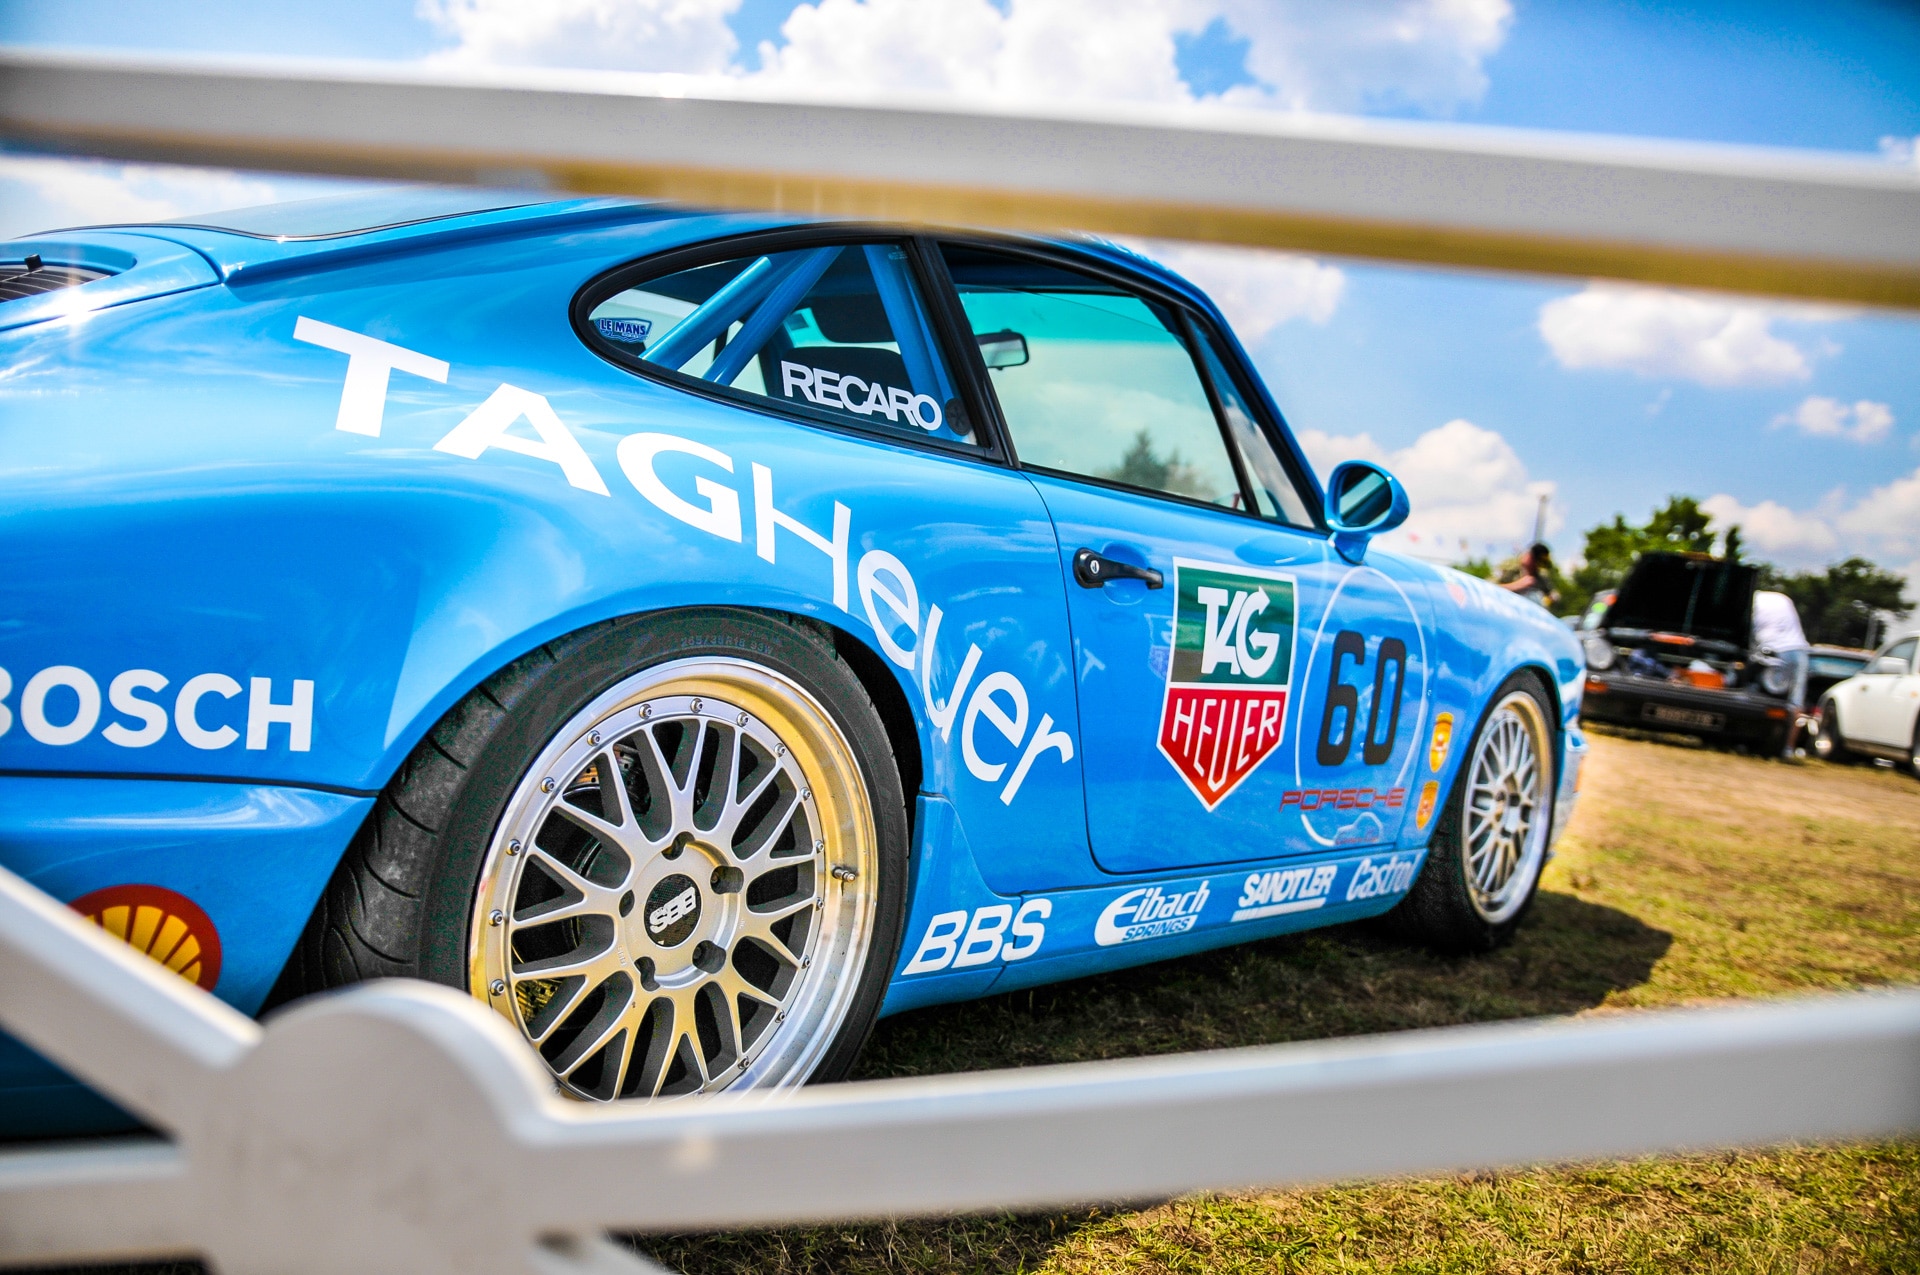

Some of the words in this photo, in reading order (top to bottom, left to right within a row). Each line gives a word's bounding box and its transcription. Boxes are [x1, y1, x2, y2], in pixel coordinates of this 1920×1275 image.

[600, 319, 612, 330] LE
[615, 321, 646, 335] MANS
[780, 360, 943, 431] RECARO
[1197, 585, 1280, 679] TAG
[0, 664, 315, 752] OSCH
[1317, 630, 1405, 766] 60
[1171, 698, 1280, 793] HEUER
[1279, 787, 1406, 813] PORSCHE
[1094, 880, 1211, 946] Eibach
[1238, 865, 1338, 908] SANDTLER
[901, 897, 1052, 976] BBS
[1122, 918, 1191, 941] SPRINGS
